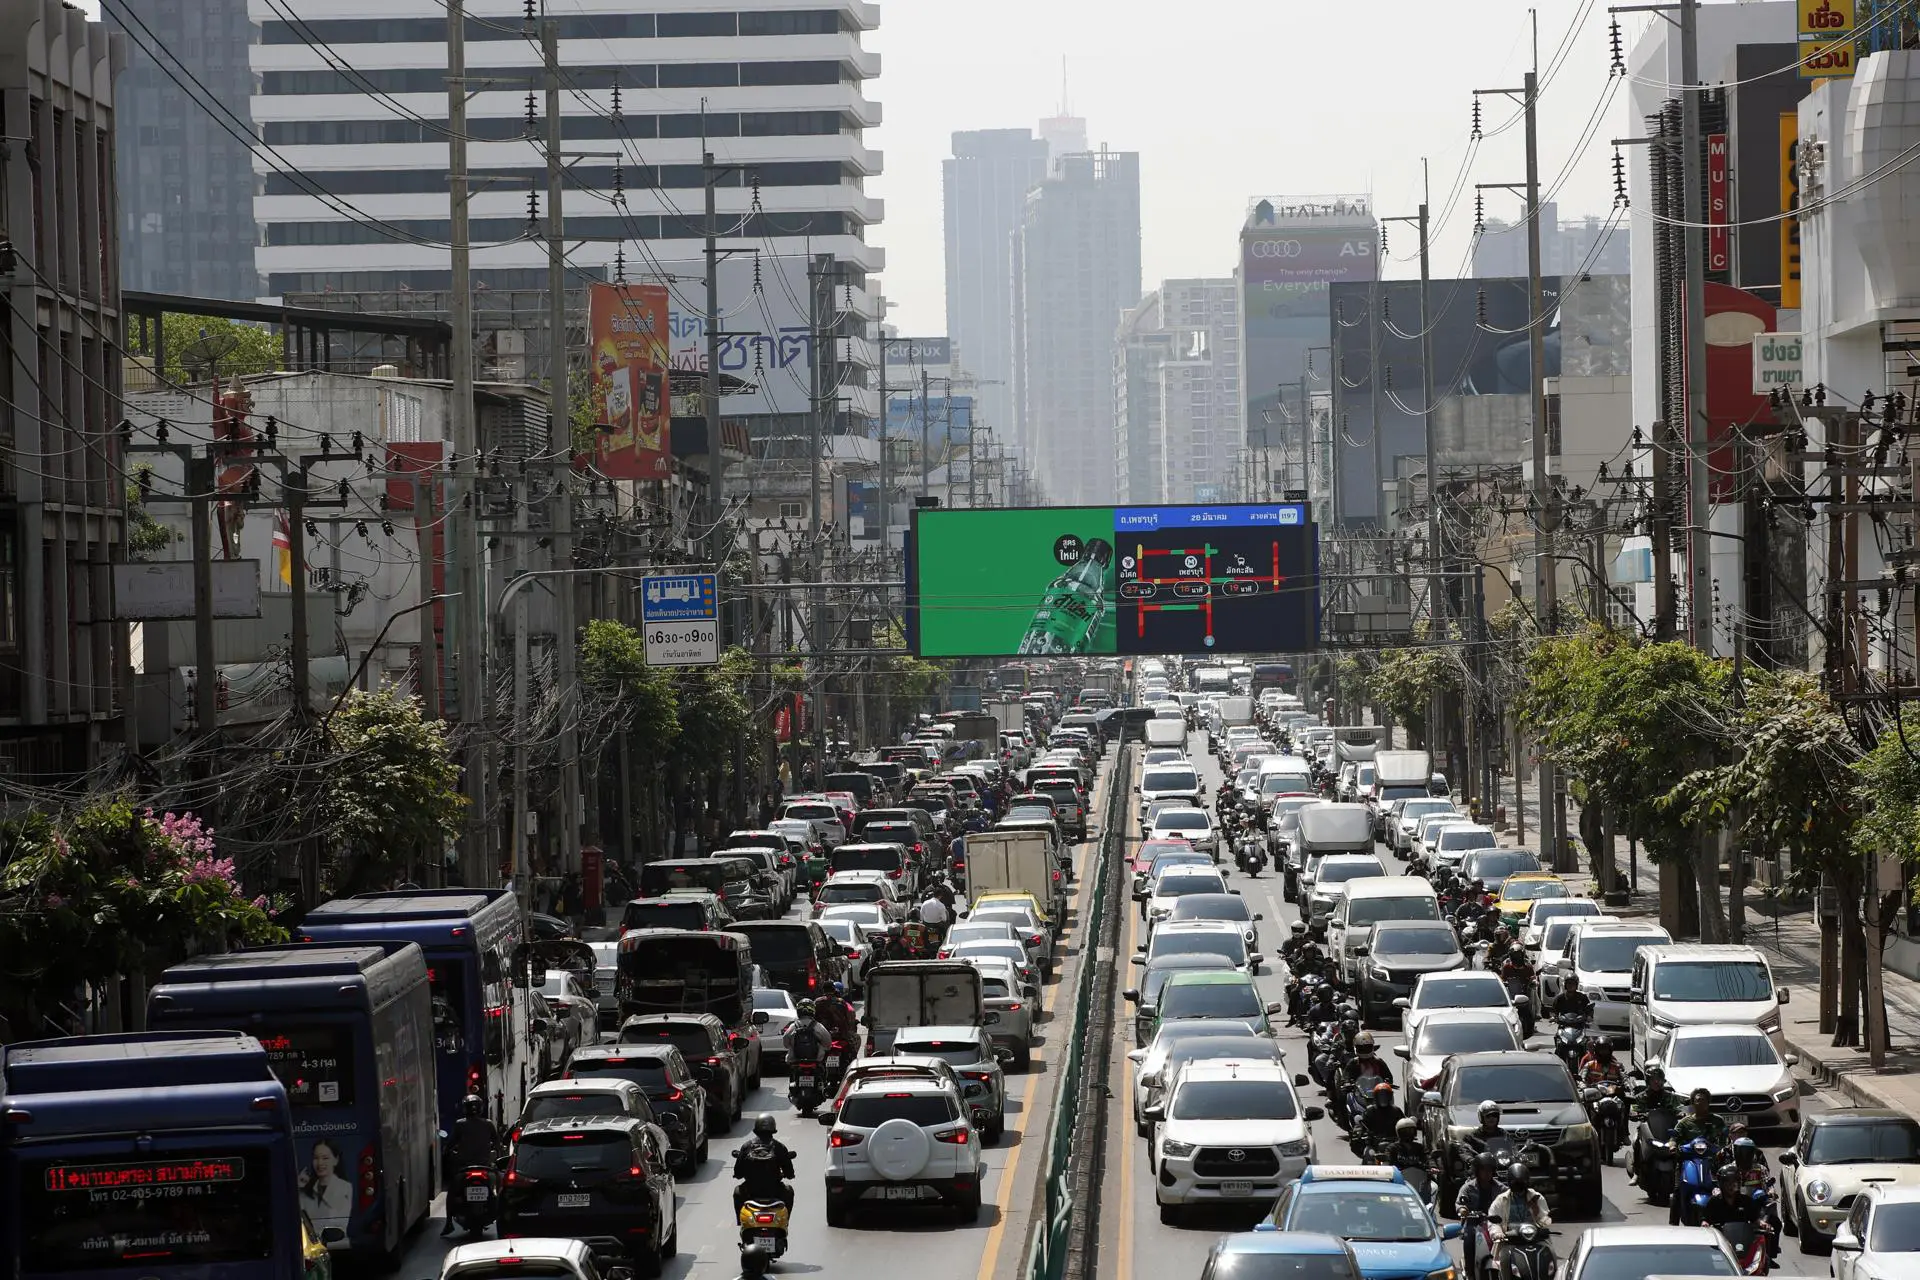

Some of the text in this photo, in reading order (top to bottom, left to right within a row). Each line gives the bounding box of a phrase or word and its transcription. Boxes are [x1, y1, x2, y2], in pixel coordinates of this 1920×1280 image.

[1805, 46, 1849, 68] ด่วน
[1280, 204, 1367, 218] ITALTHAI
[1711, 143, 1725, 267] MUSIC
[1339, 241, 1370, 257] A5
[1280, 267, 1348, 277] The only change?
[1263, 278, 1331, 293] Everyth
[648, 629, 714, 644] 0630-0900
